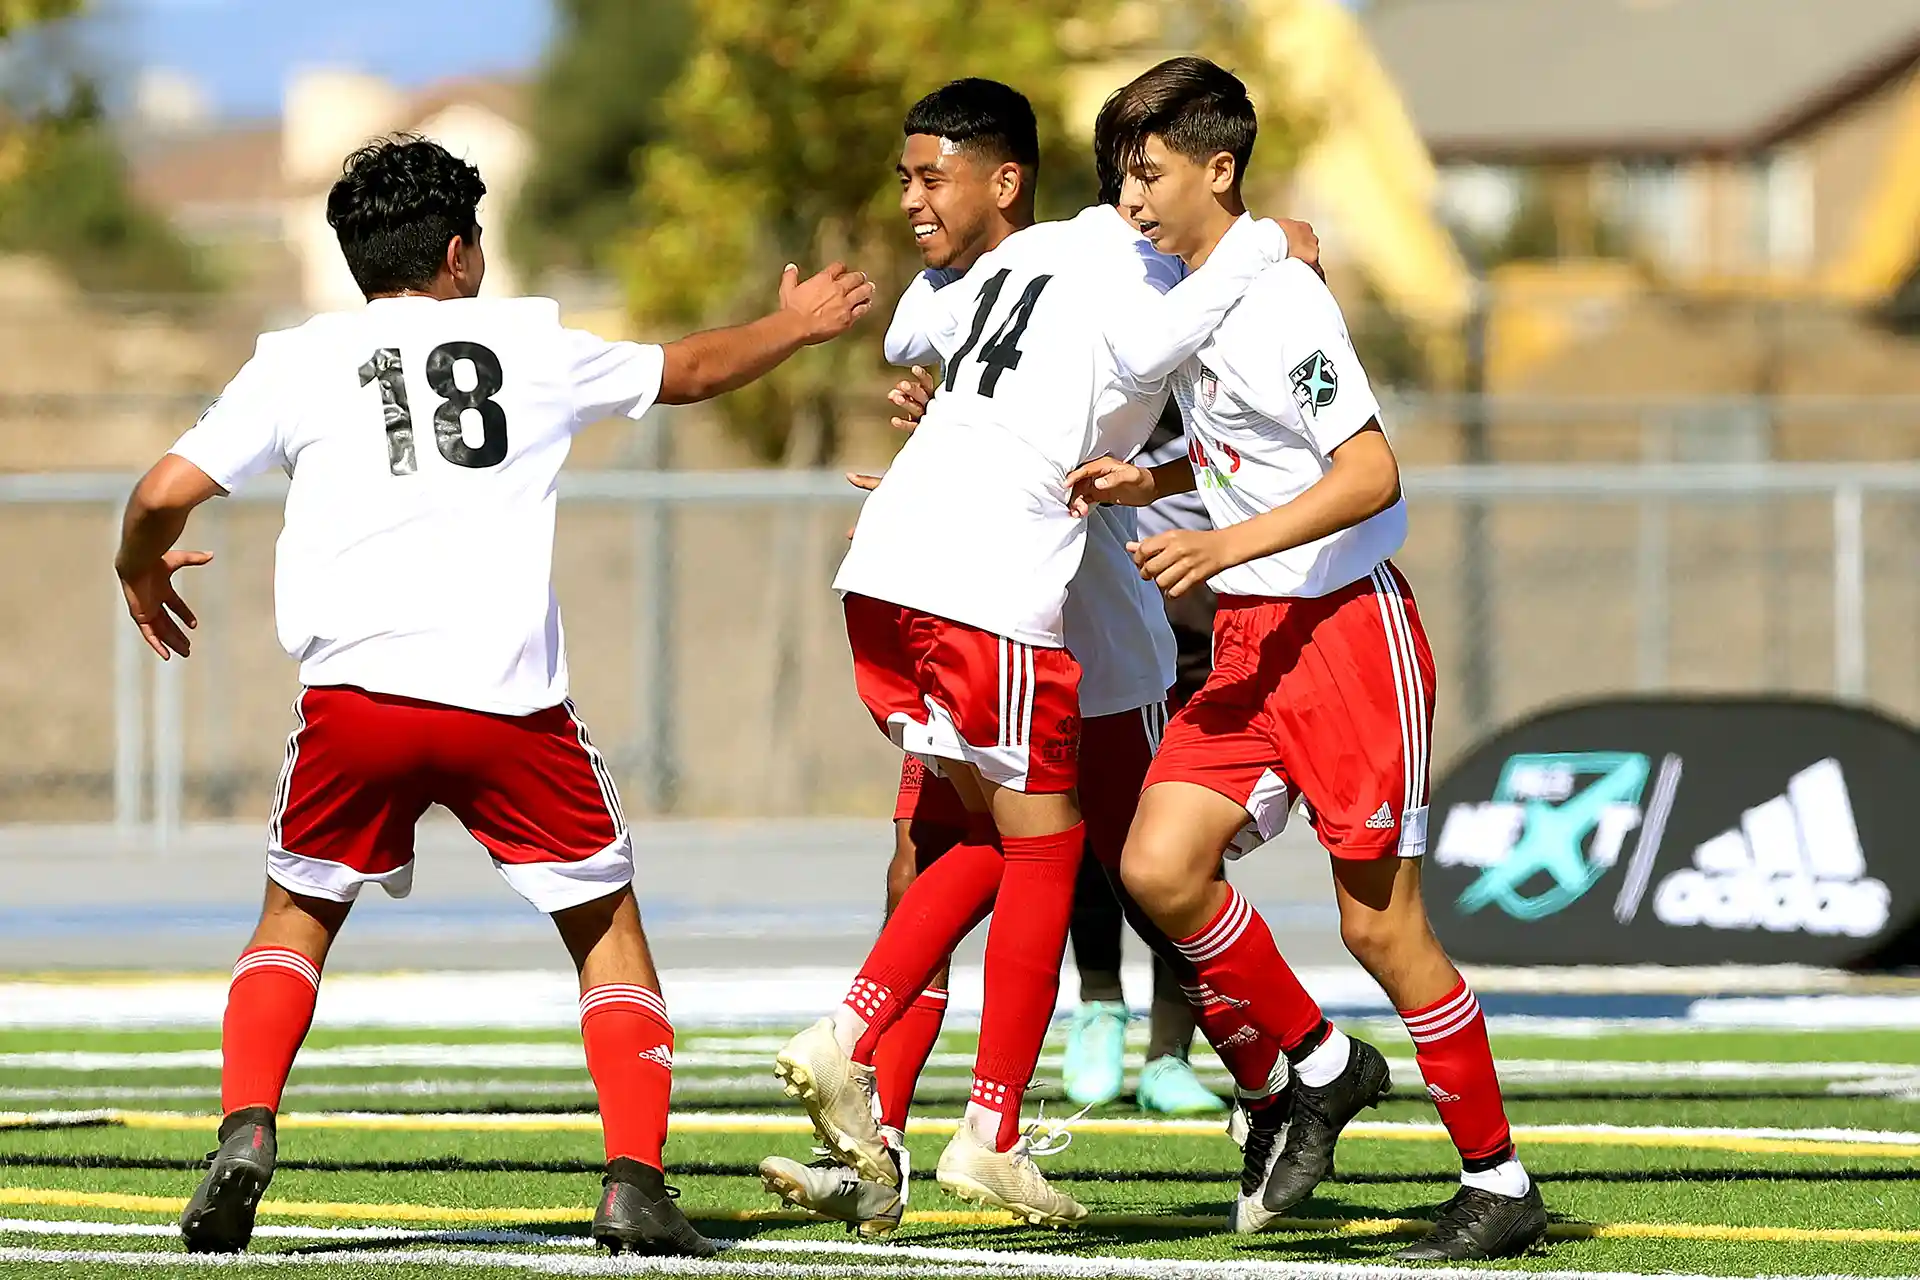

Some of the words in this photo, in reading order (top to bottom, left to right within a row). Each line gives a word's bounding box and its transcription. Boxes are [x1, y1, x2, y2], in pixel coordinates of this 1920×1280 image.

[945, 267, 1054, 398] 14
[358, 341, 508, 476] 18
[1365, 818, 1395, 829] adidas
[1652, 867, 1893, 938] adidas
[638, 1051, 673, 1071] adida
